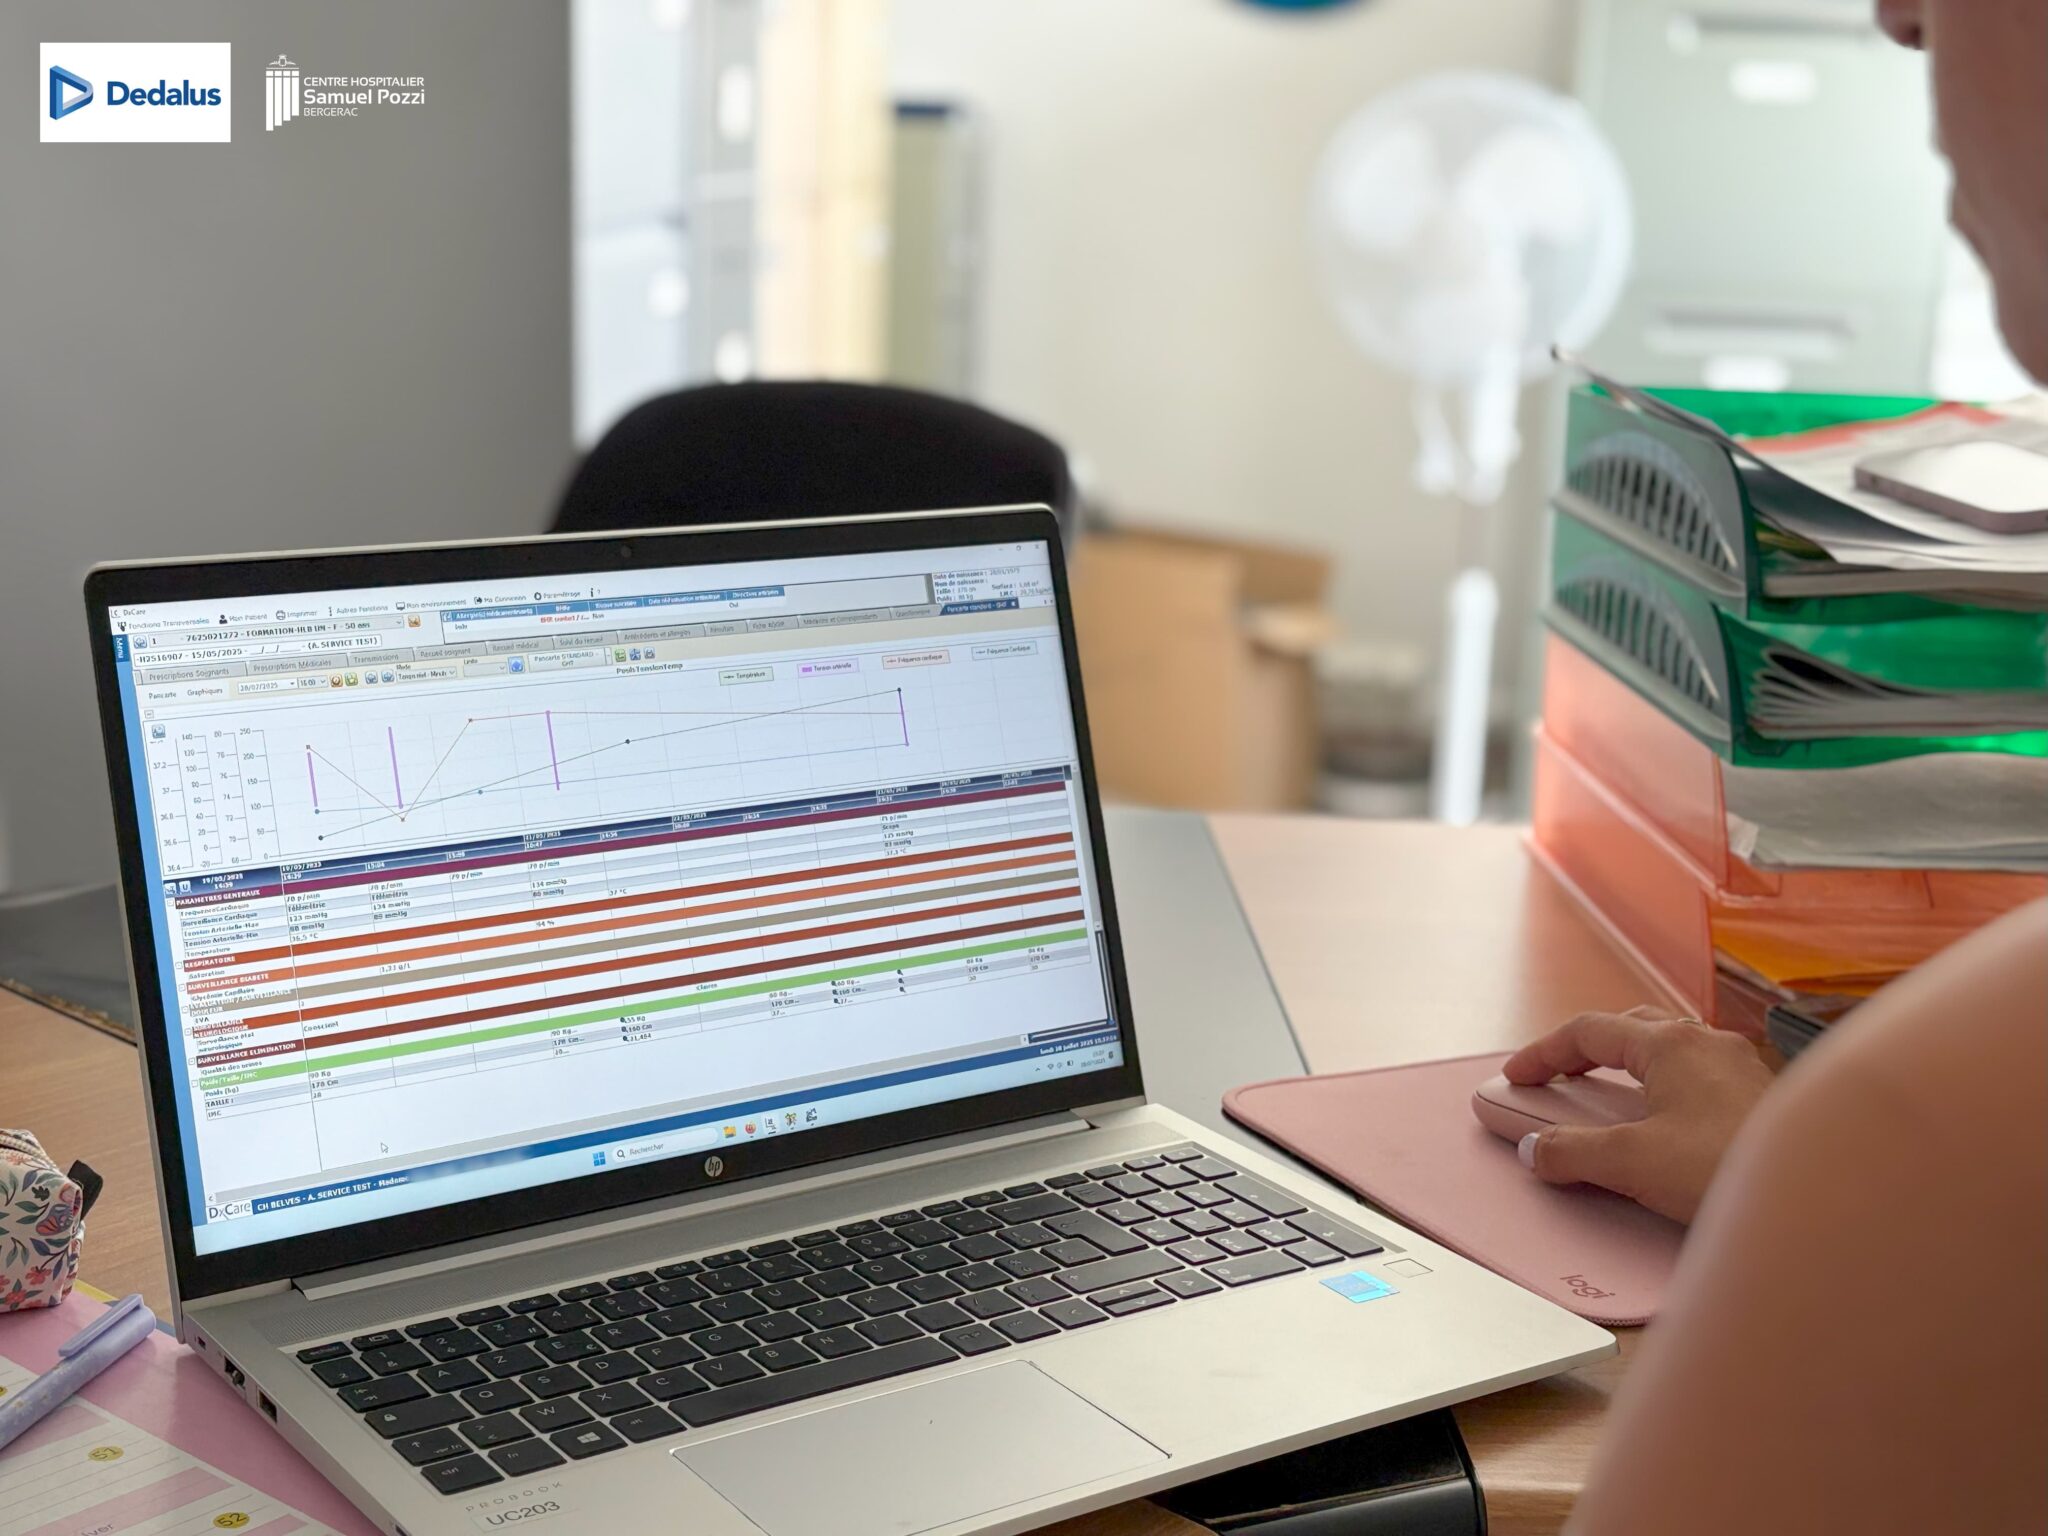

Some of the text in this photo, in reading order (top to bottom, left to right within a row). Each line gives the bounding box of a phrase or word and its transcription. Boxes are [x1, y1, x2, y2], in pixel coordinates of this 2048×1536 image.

[321, 639, 353, 648] SERVICE
[149, 667, 229, 681] Prescriptions Soignants
[187, 688, 223, 698] Graphiques
[198, 1043, 296, 1065] SURVEILLANCE ELIMINATION
[208, 1202, 251, 1220] DxCare
[317, 1186, 351, 1199] SERVICE
[352, 1182, 371, 1193] TEST
[1560, 1274, 1616, 1299] logi
[91, 1447, 118, 1461] 51
[465, 1480, 563, 1512] PROBOOK
[216, 1512, 248, 1527] 52
[486, 1500, 561, 1526] UC203
